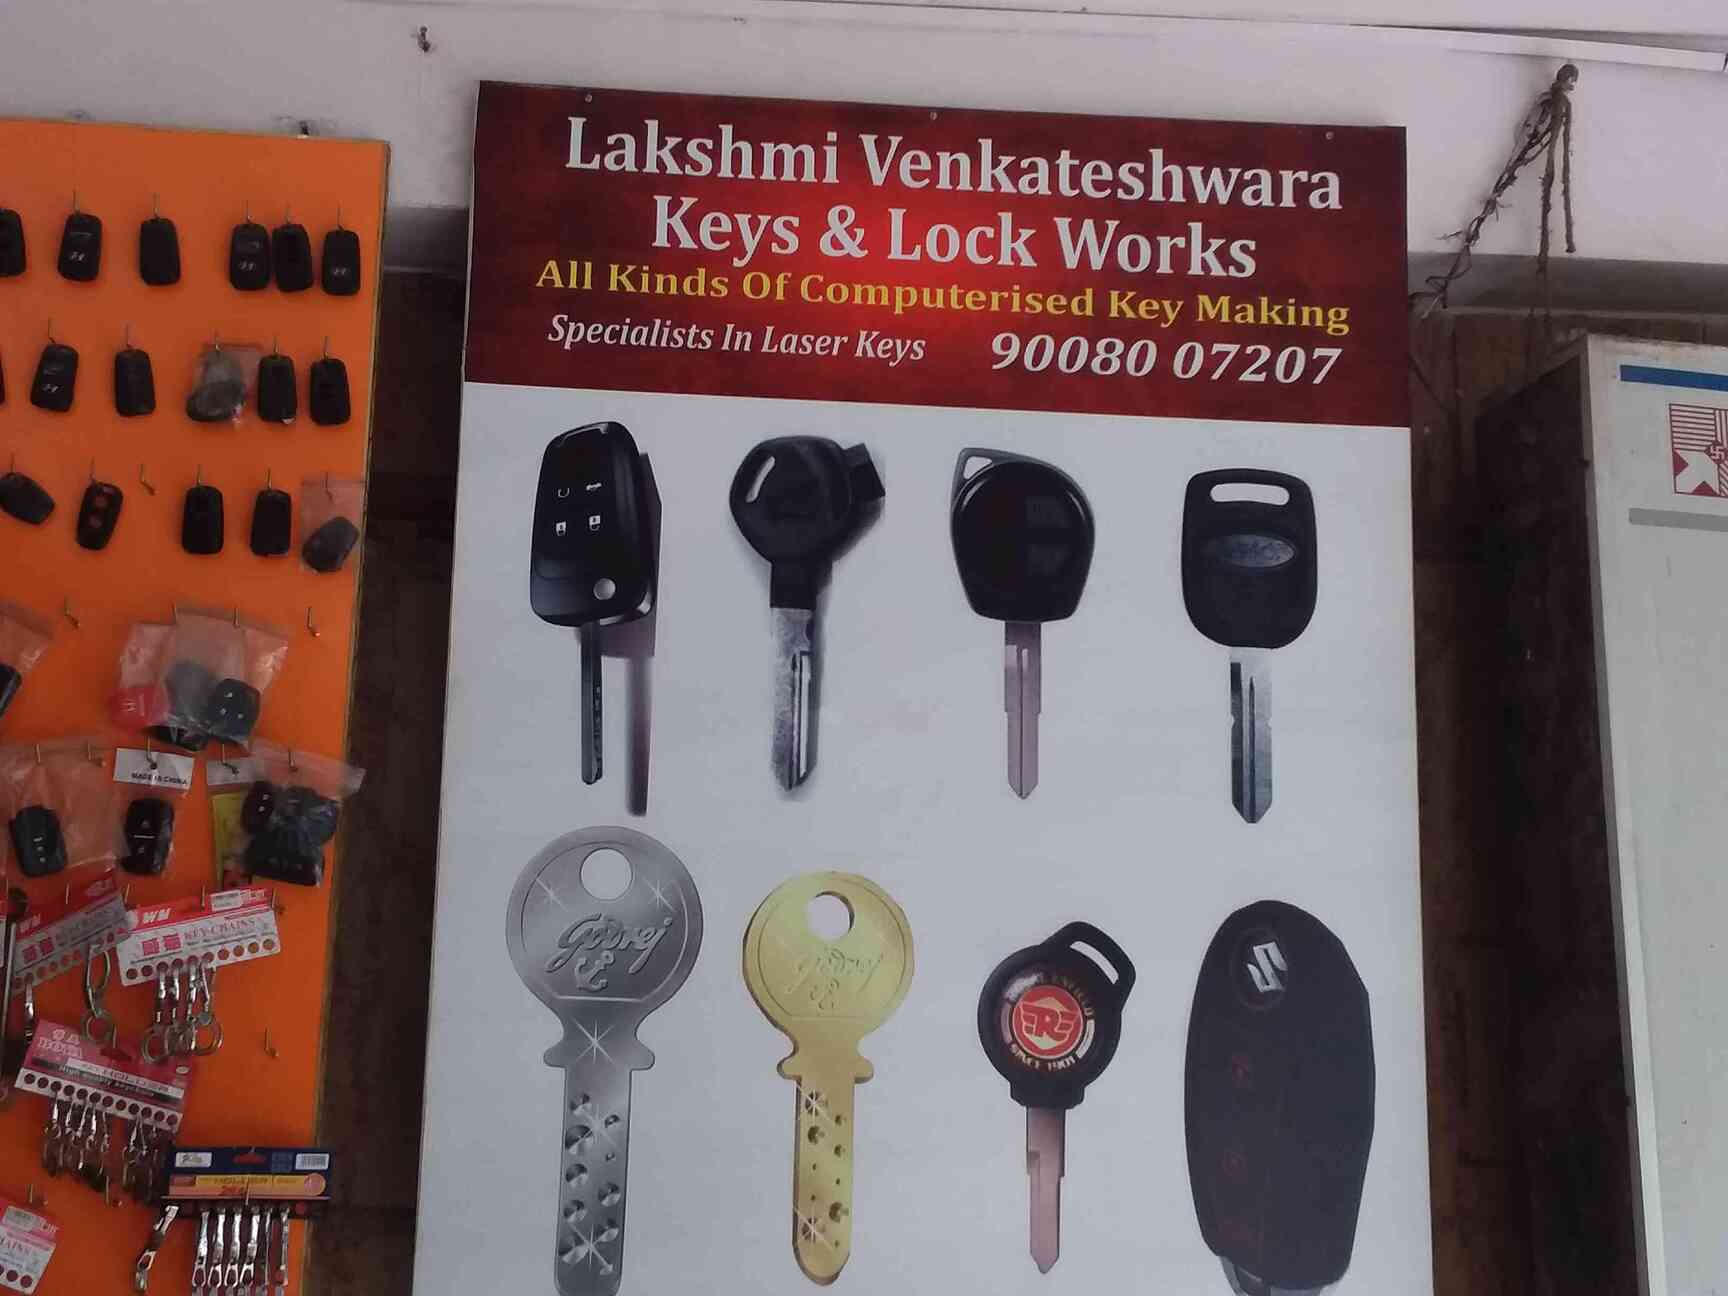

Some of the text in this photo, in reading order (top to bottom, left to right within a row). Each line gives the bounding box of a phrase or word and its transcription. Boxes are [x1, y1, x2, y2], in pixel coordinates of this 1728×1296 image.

[565, 116, 1343, 210] Lakshmi Venkateshwara
[651, 195, 1257, 278] Keys & Lock Works
[536, 260, 1350, 336] All Kinds Of Computerised Key Making
[547, 314, 926, 367] Specialists In Laser Keys
[991, 332, 1343, 385] 90080 07207
